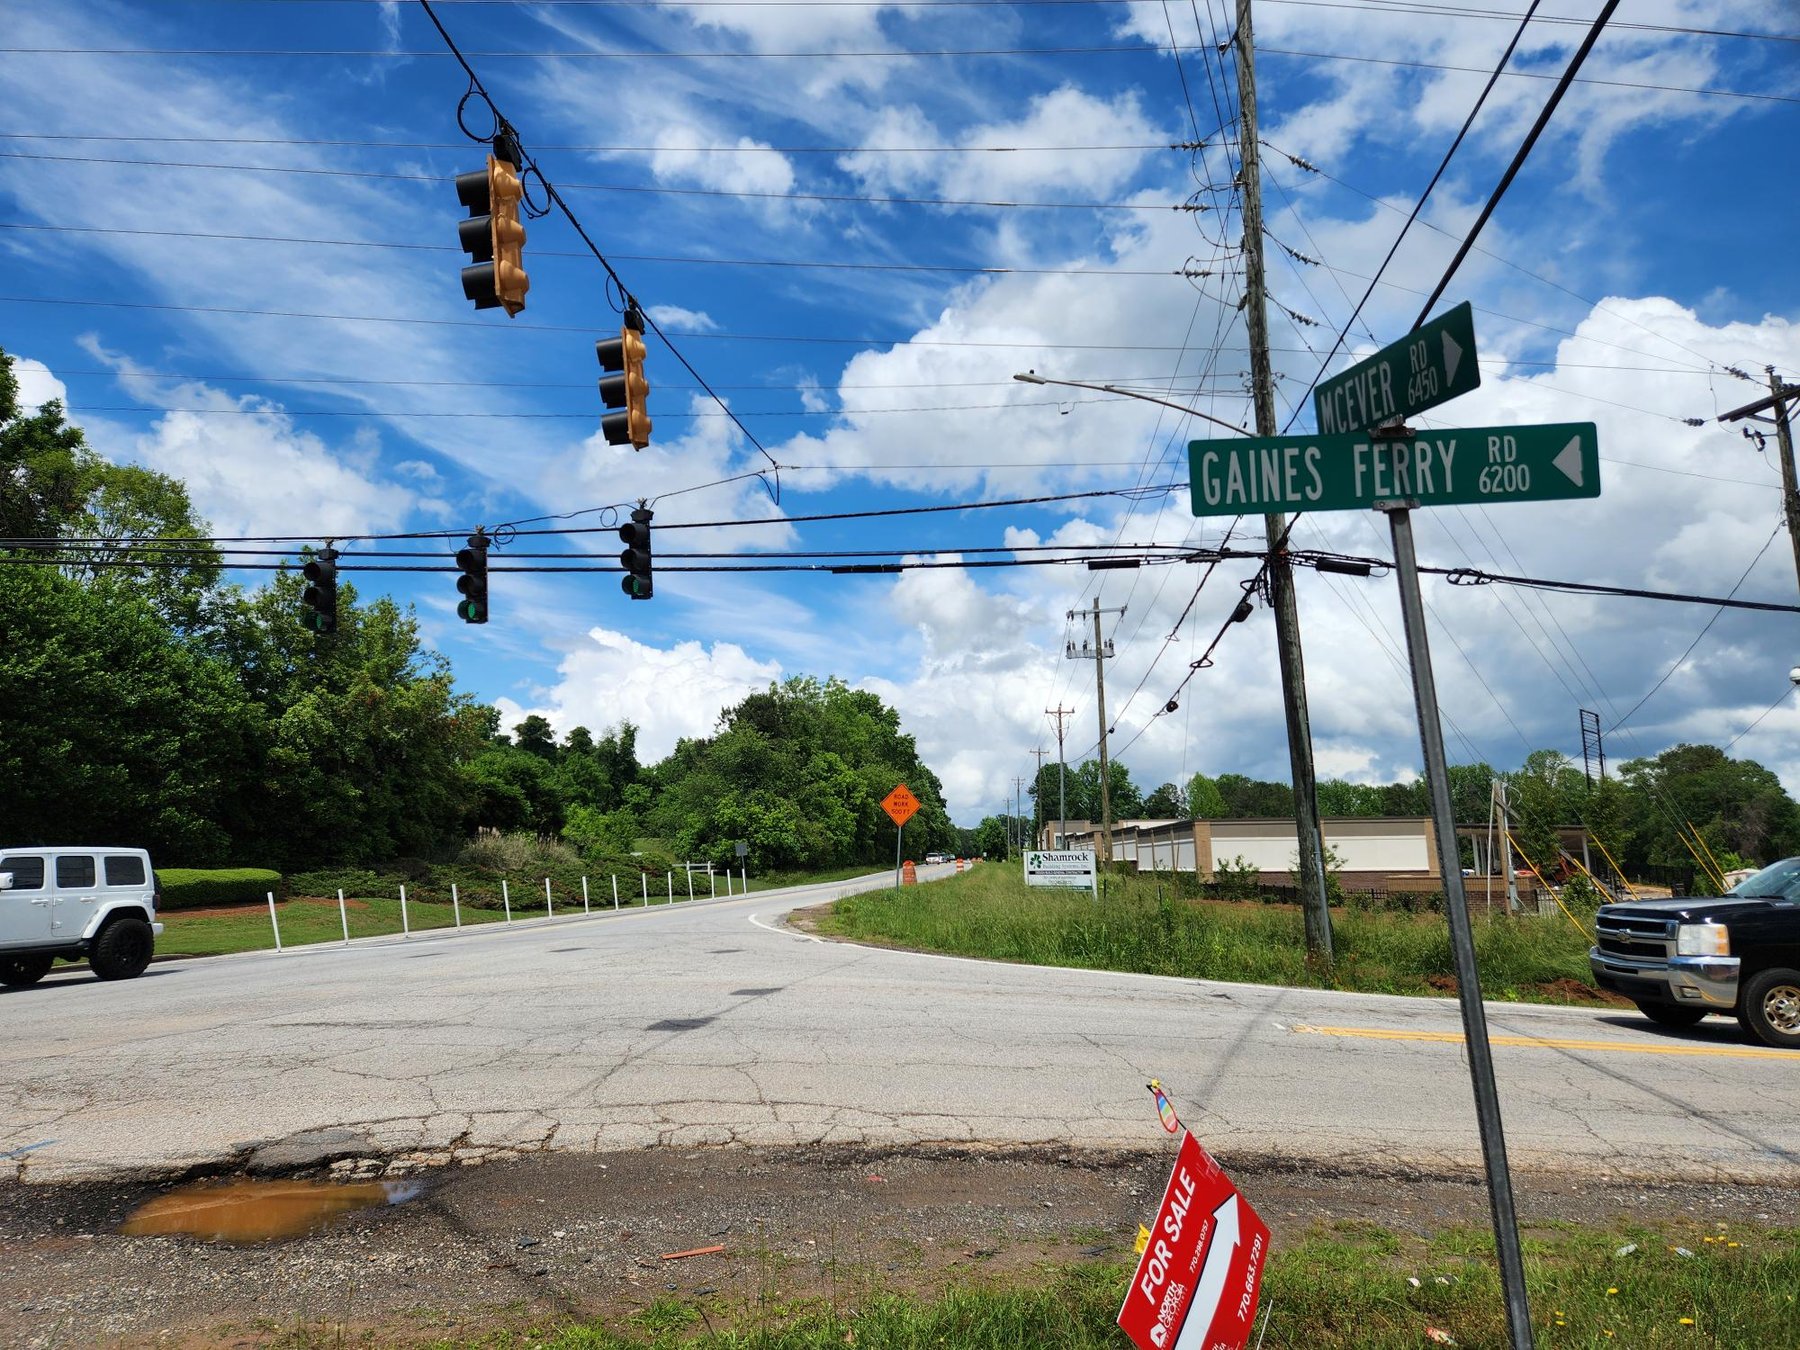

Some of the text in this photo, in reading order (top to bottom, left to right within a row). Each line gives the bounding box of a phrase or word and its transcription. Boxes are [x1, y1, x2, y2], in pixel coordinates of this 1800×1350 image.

[1410, 340, 1428, 374] RD
[1320, 361, 1395, 435] MCEVER
[1408, 366, 1438, 407] 6450
[1488, 435, 1517, 463] RD
[1202, 440, 1456, 505] GAINES FERRY
[1479, 464, 1530, 494] 6200
[1042, 853, 1088, 861] Shamrock
[1141, 1167, 1196, 1306] FOR SALE
[1237, 1233, 1262, 1322] 770.663.7291
[1157, 1280, 1178, 1323] NORTH
[1163, 1283, 1184, 1328] GEORGIA
